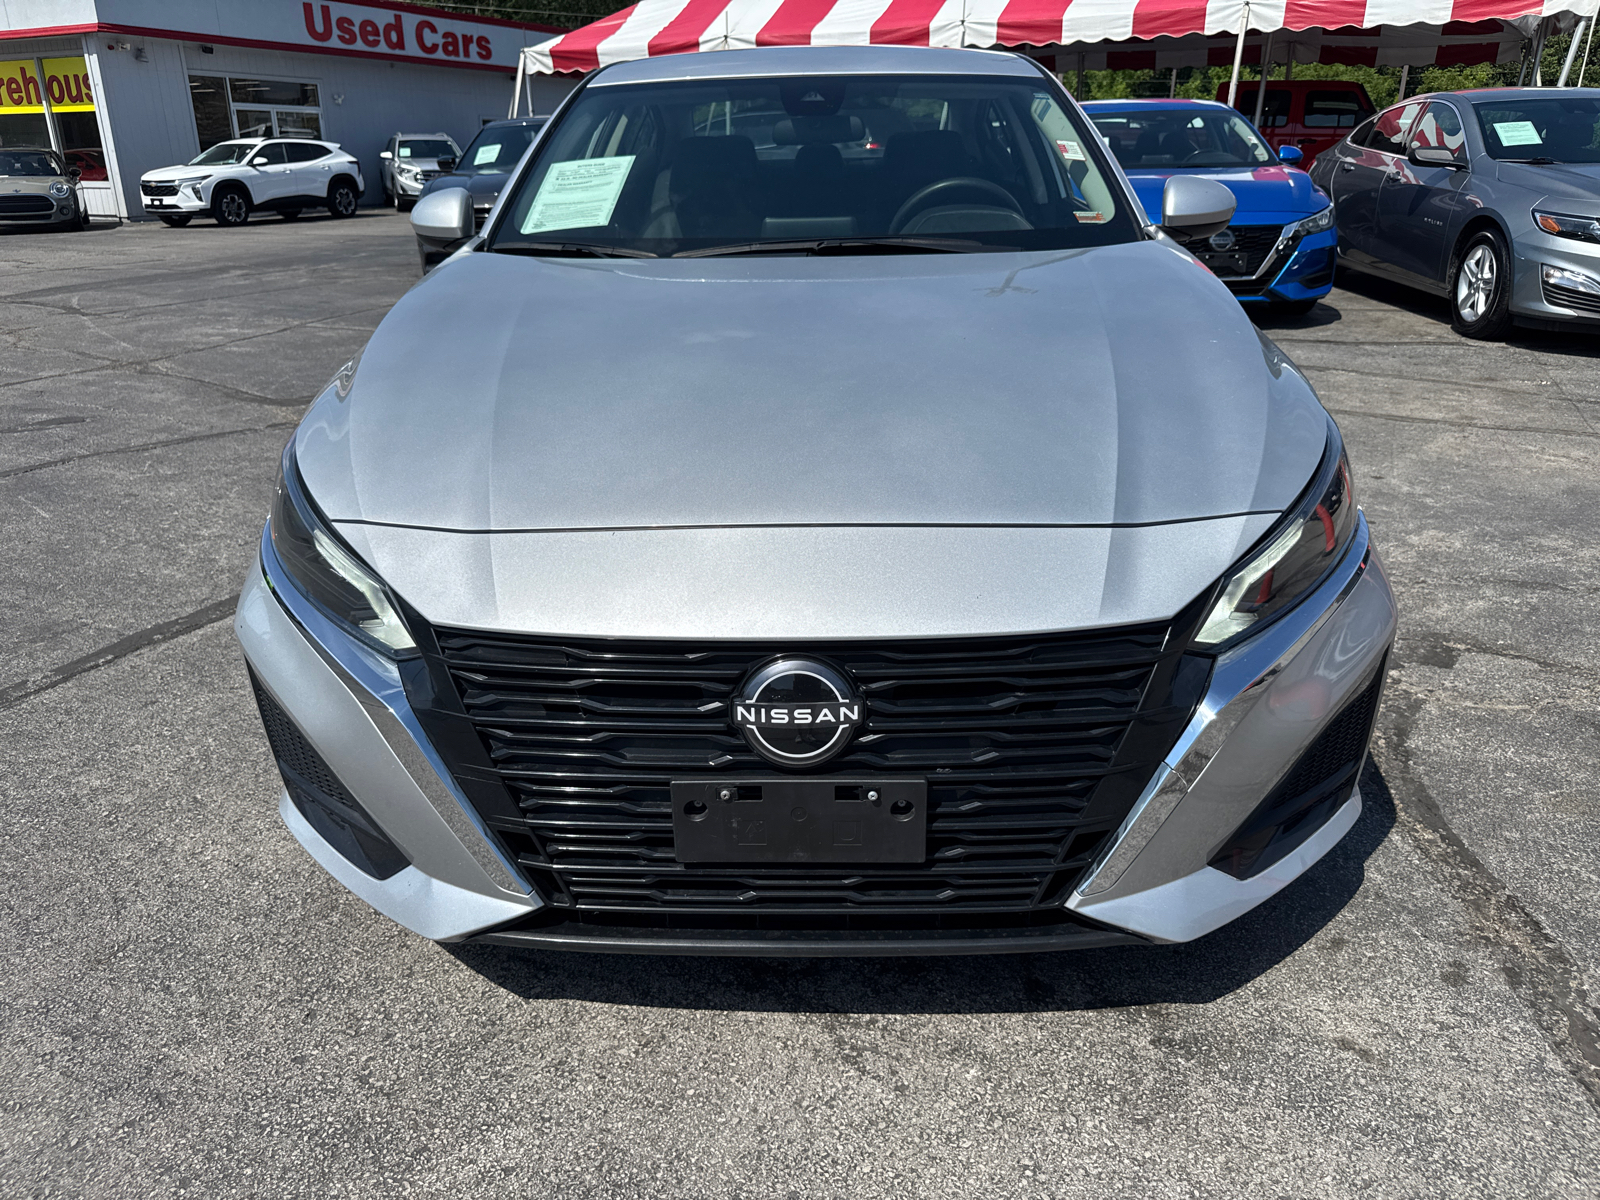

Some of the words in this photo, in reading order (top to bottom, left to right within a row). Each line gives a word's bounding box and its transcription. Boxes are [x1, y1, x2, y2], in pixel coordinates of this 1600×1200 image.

[303, 2, 405, 50] Used
[415, 20, 492, 60] Cars
[737, 705, 858, 724] NISSAN
